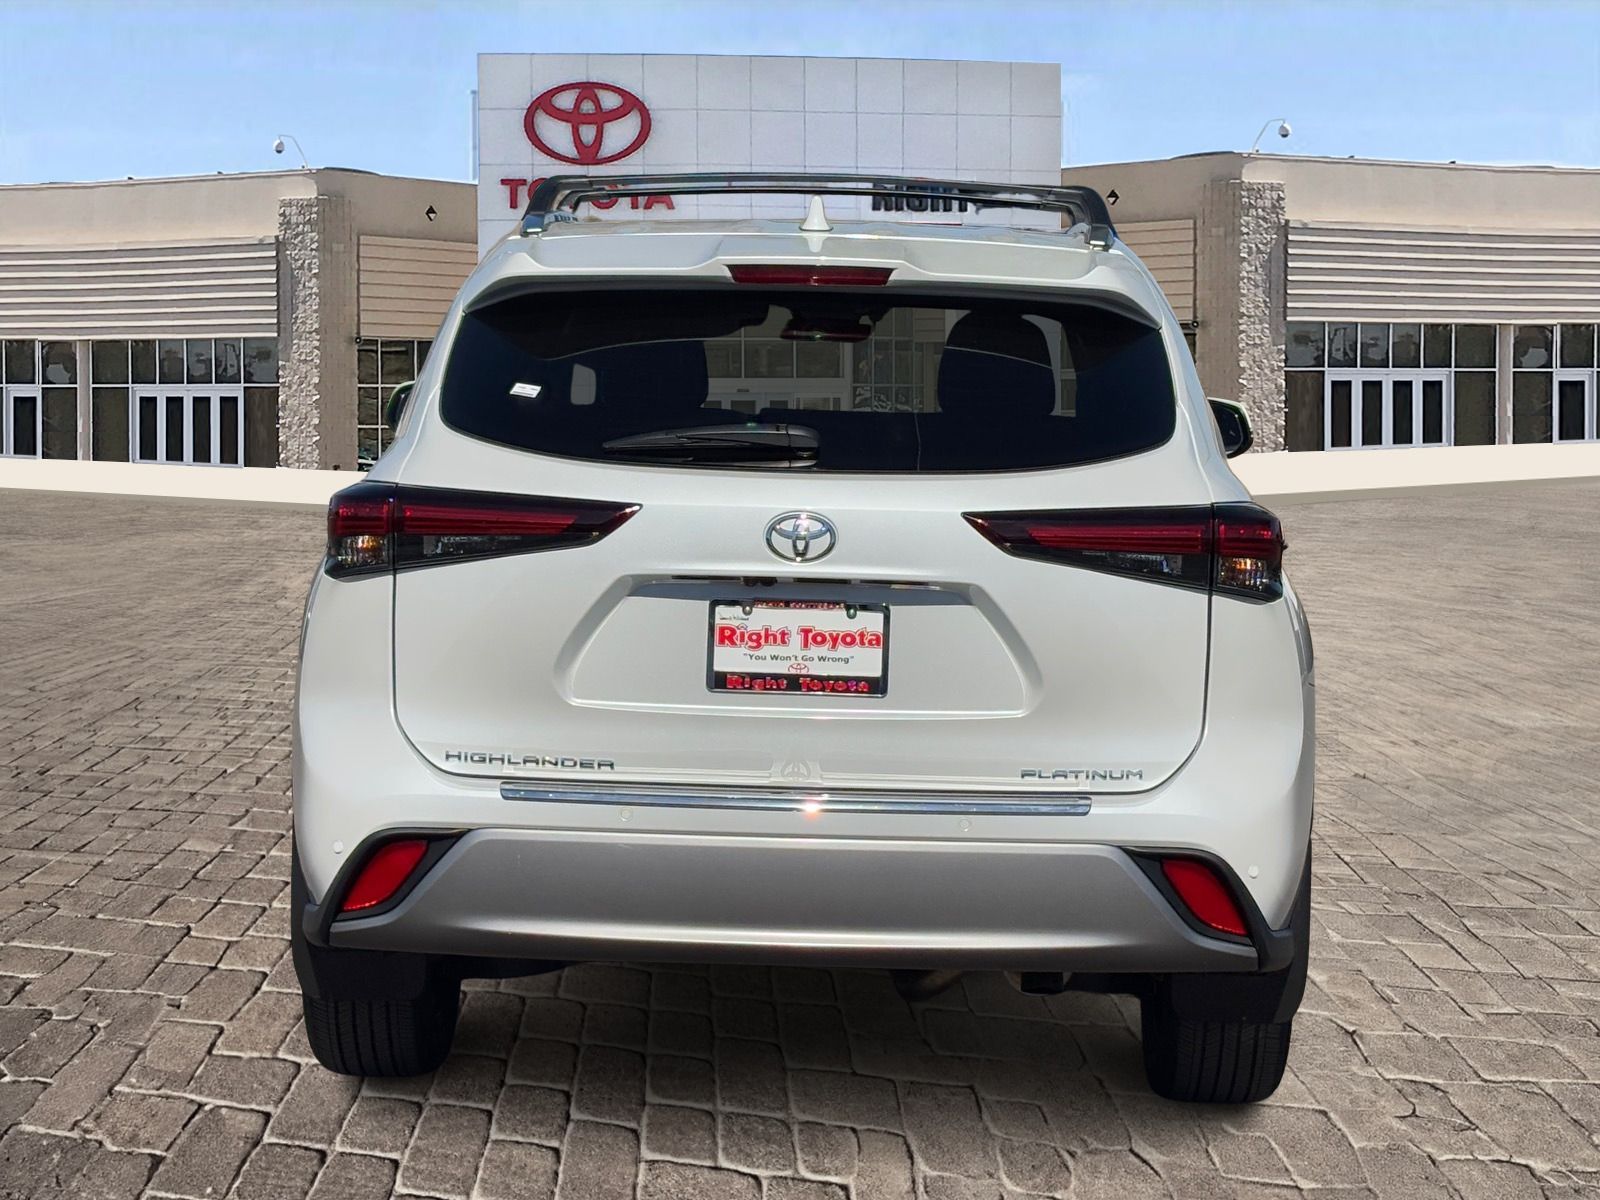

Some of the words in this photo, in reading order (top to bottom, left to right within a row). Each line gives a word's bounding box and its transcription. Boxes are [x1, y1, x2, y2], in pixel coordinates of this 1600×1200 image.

[716, 623, 791, 651] Right
[797, 626, 883, 651] Toyota
[769, 653, 798, 662] Won't
[801, 654, 815, 662] Go
[726, 674, 787, 691] Right
[799, 677, 869, 692] Toyota
[445, 750, 615, 770] HIGHLANDER
[1020, 768, 1143, 780] PLATINUM
